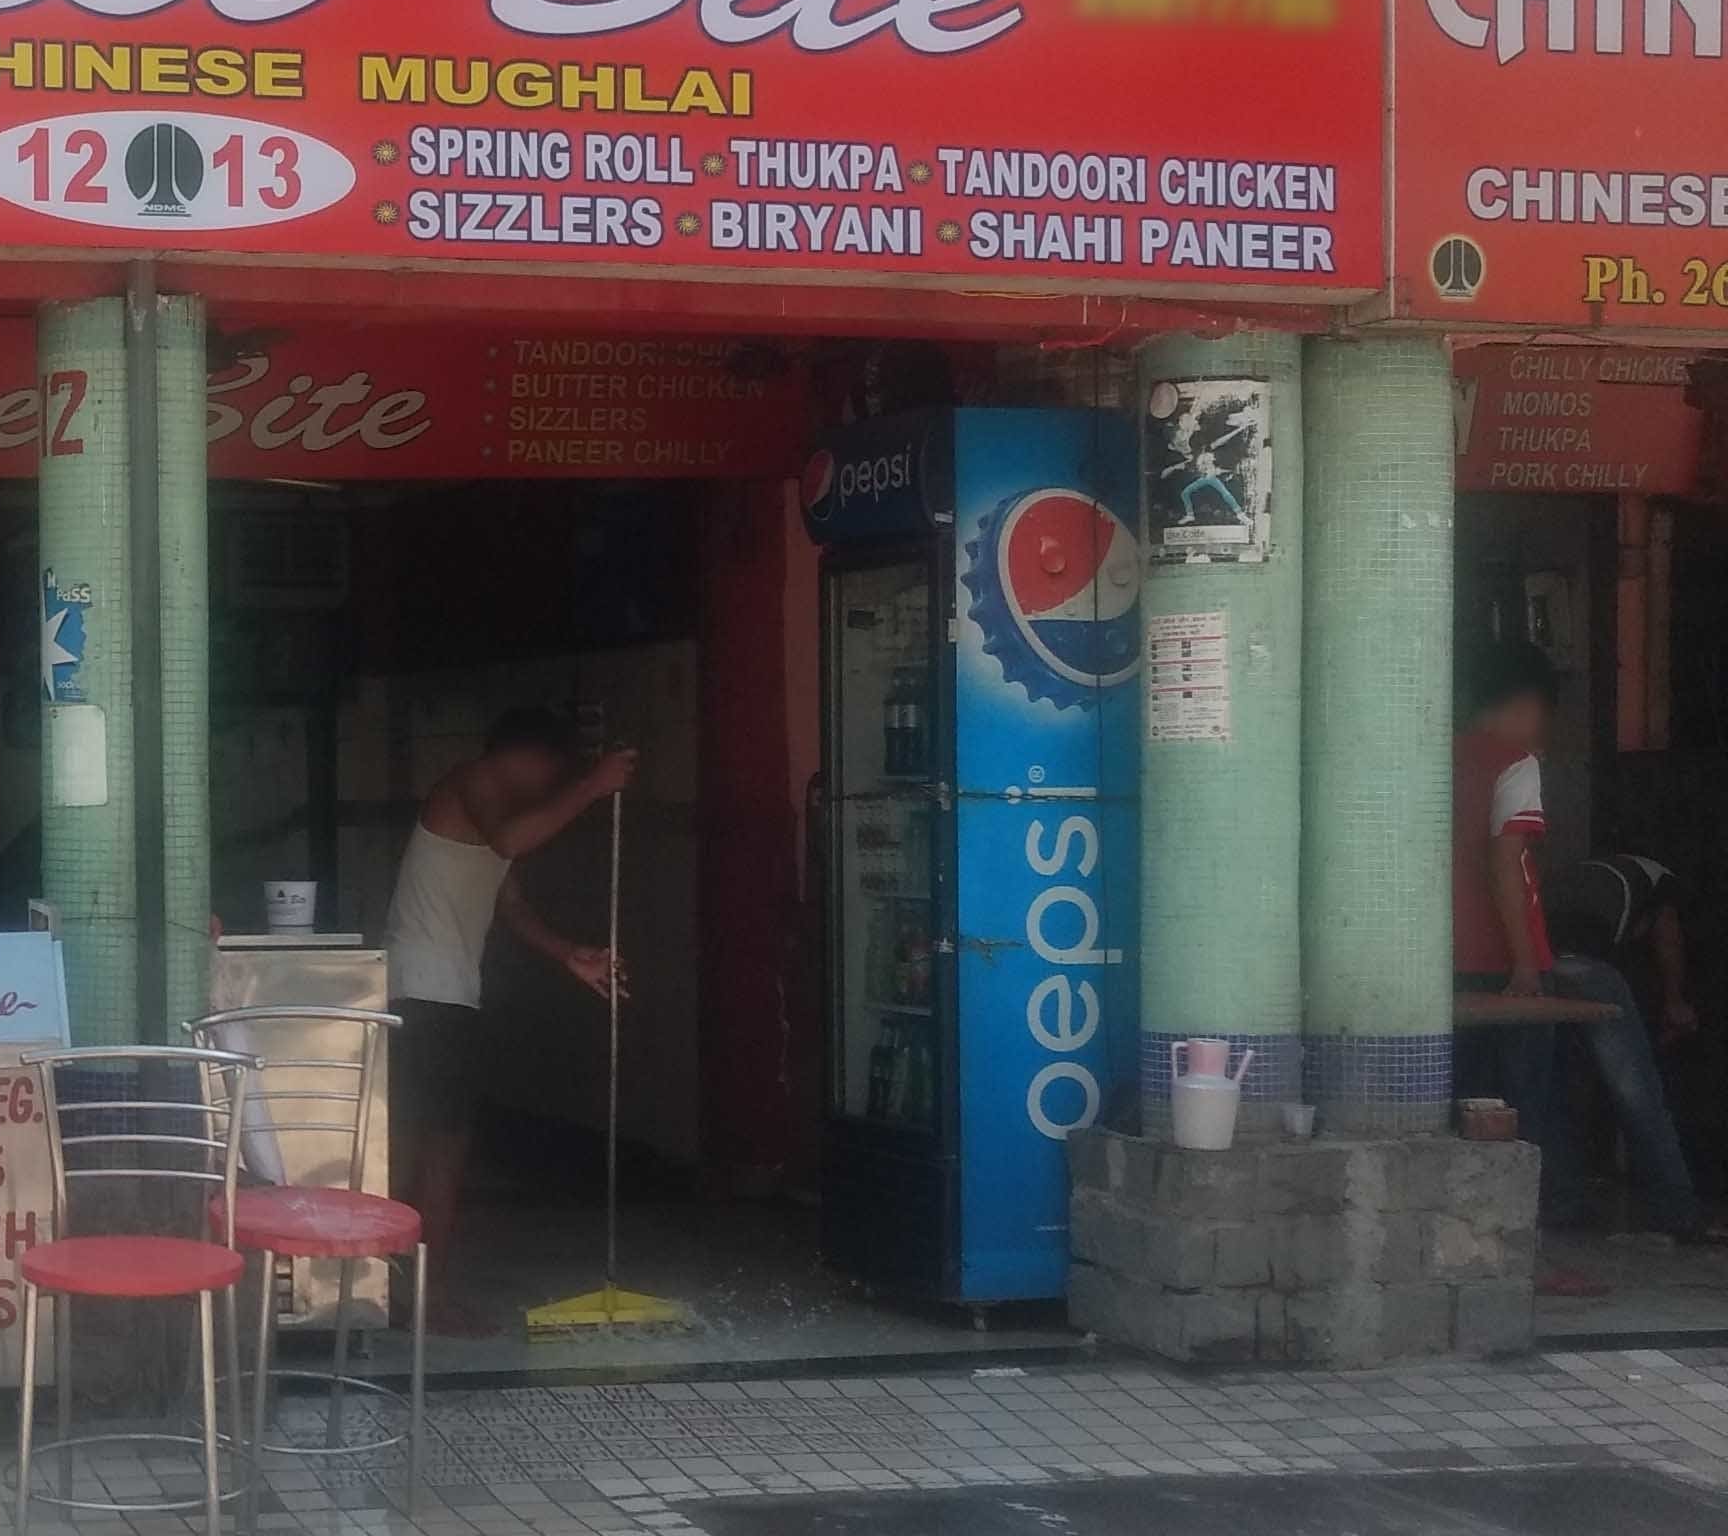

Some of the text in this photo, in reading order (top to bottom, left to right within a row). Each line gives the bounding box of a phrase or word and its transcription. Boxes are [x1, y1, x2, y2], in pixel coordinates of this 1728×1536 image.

[360, 55, 752, 117] MUGHLAI
[15, 127, 303, 211] 12 13
[409, 125, 1337, 213] SPRING ROLL THUKPA TANDOORI CHICKEN
[407, 190, 1336, 273] SIZZLERS BIRYANI SHAHI PANEER
[1582, 255, 1665, 306] Ph.
[1509, 352, 1594, 382] CHILLY
[510, 372, 627, 401] BUTTER
[1502, 391, 1593, 417] MOMOS
[509, 406, 648, 433] SIZZLERS
[507, 438, 731, 466] PANEER CHILLY
[1497, 426, 1593, 453] THUKPA
[838, 445, 912, 505] pepsi
[1489, 463, 1649, 489] PORK CHILLY
